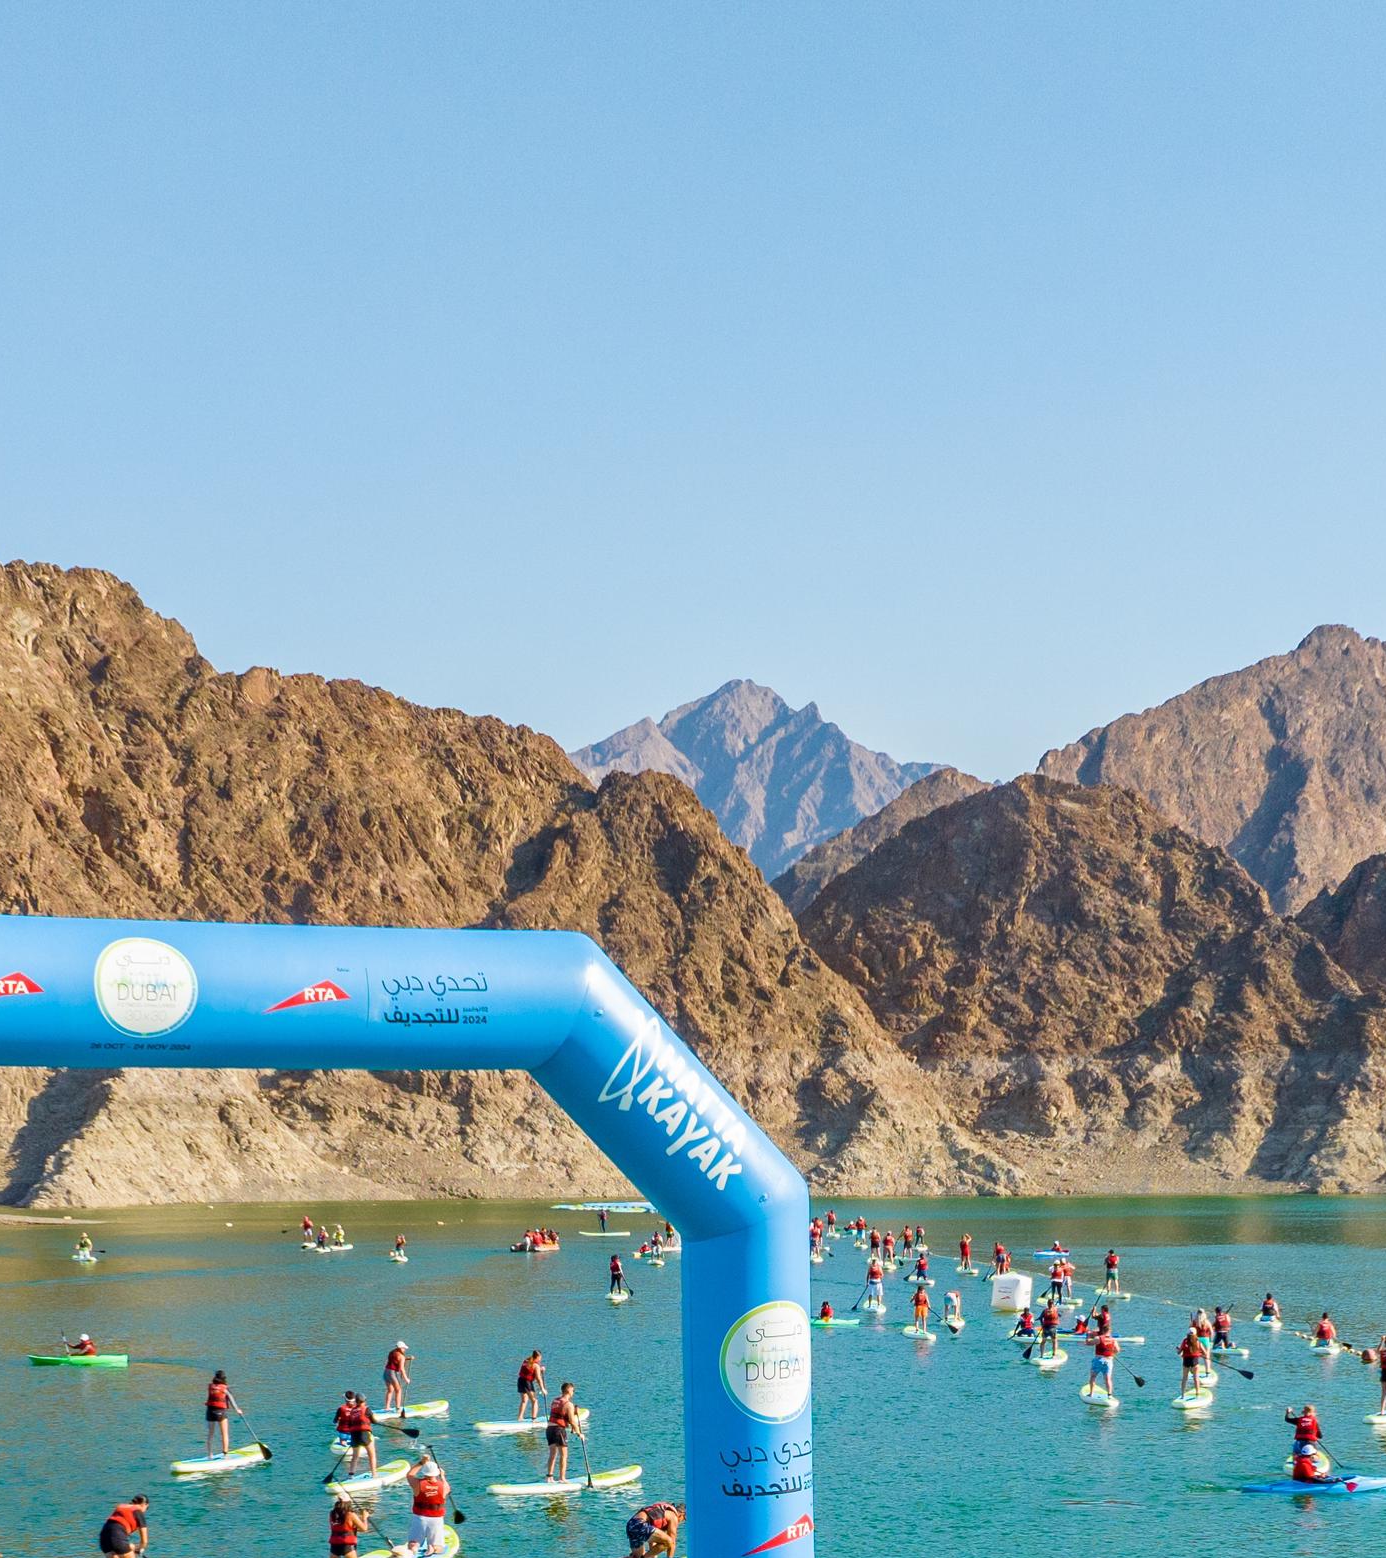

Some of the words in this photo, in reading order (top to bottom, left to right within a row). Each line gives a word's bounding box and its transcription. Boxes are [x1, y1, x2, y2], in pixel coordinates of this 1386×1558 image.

[117, 982, 177, 1002] DUBAI
[303, 987, 337, 1001] RTA
[381, 975, 424, 1001] دبي
[428, 972, 488, 1001] تحدي
[383, 1006, 460, 1027] للتجديف
[462, 1015, 488, 1025] 2024
[103, 1042, 126, 1052] OCT
[146, 1043, 168, 1051] NOV
[656, 1044, 747, 1157] HATTA
[637, 1076, 743, 1191] KAYAK
[720, 1446, 768, 1472] دبي
[722, 1475, 802, 1501] للتجديف
[786, 1522, 810, 1540] RTA
